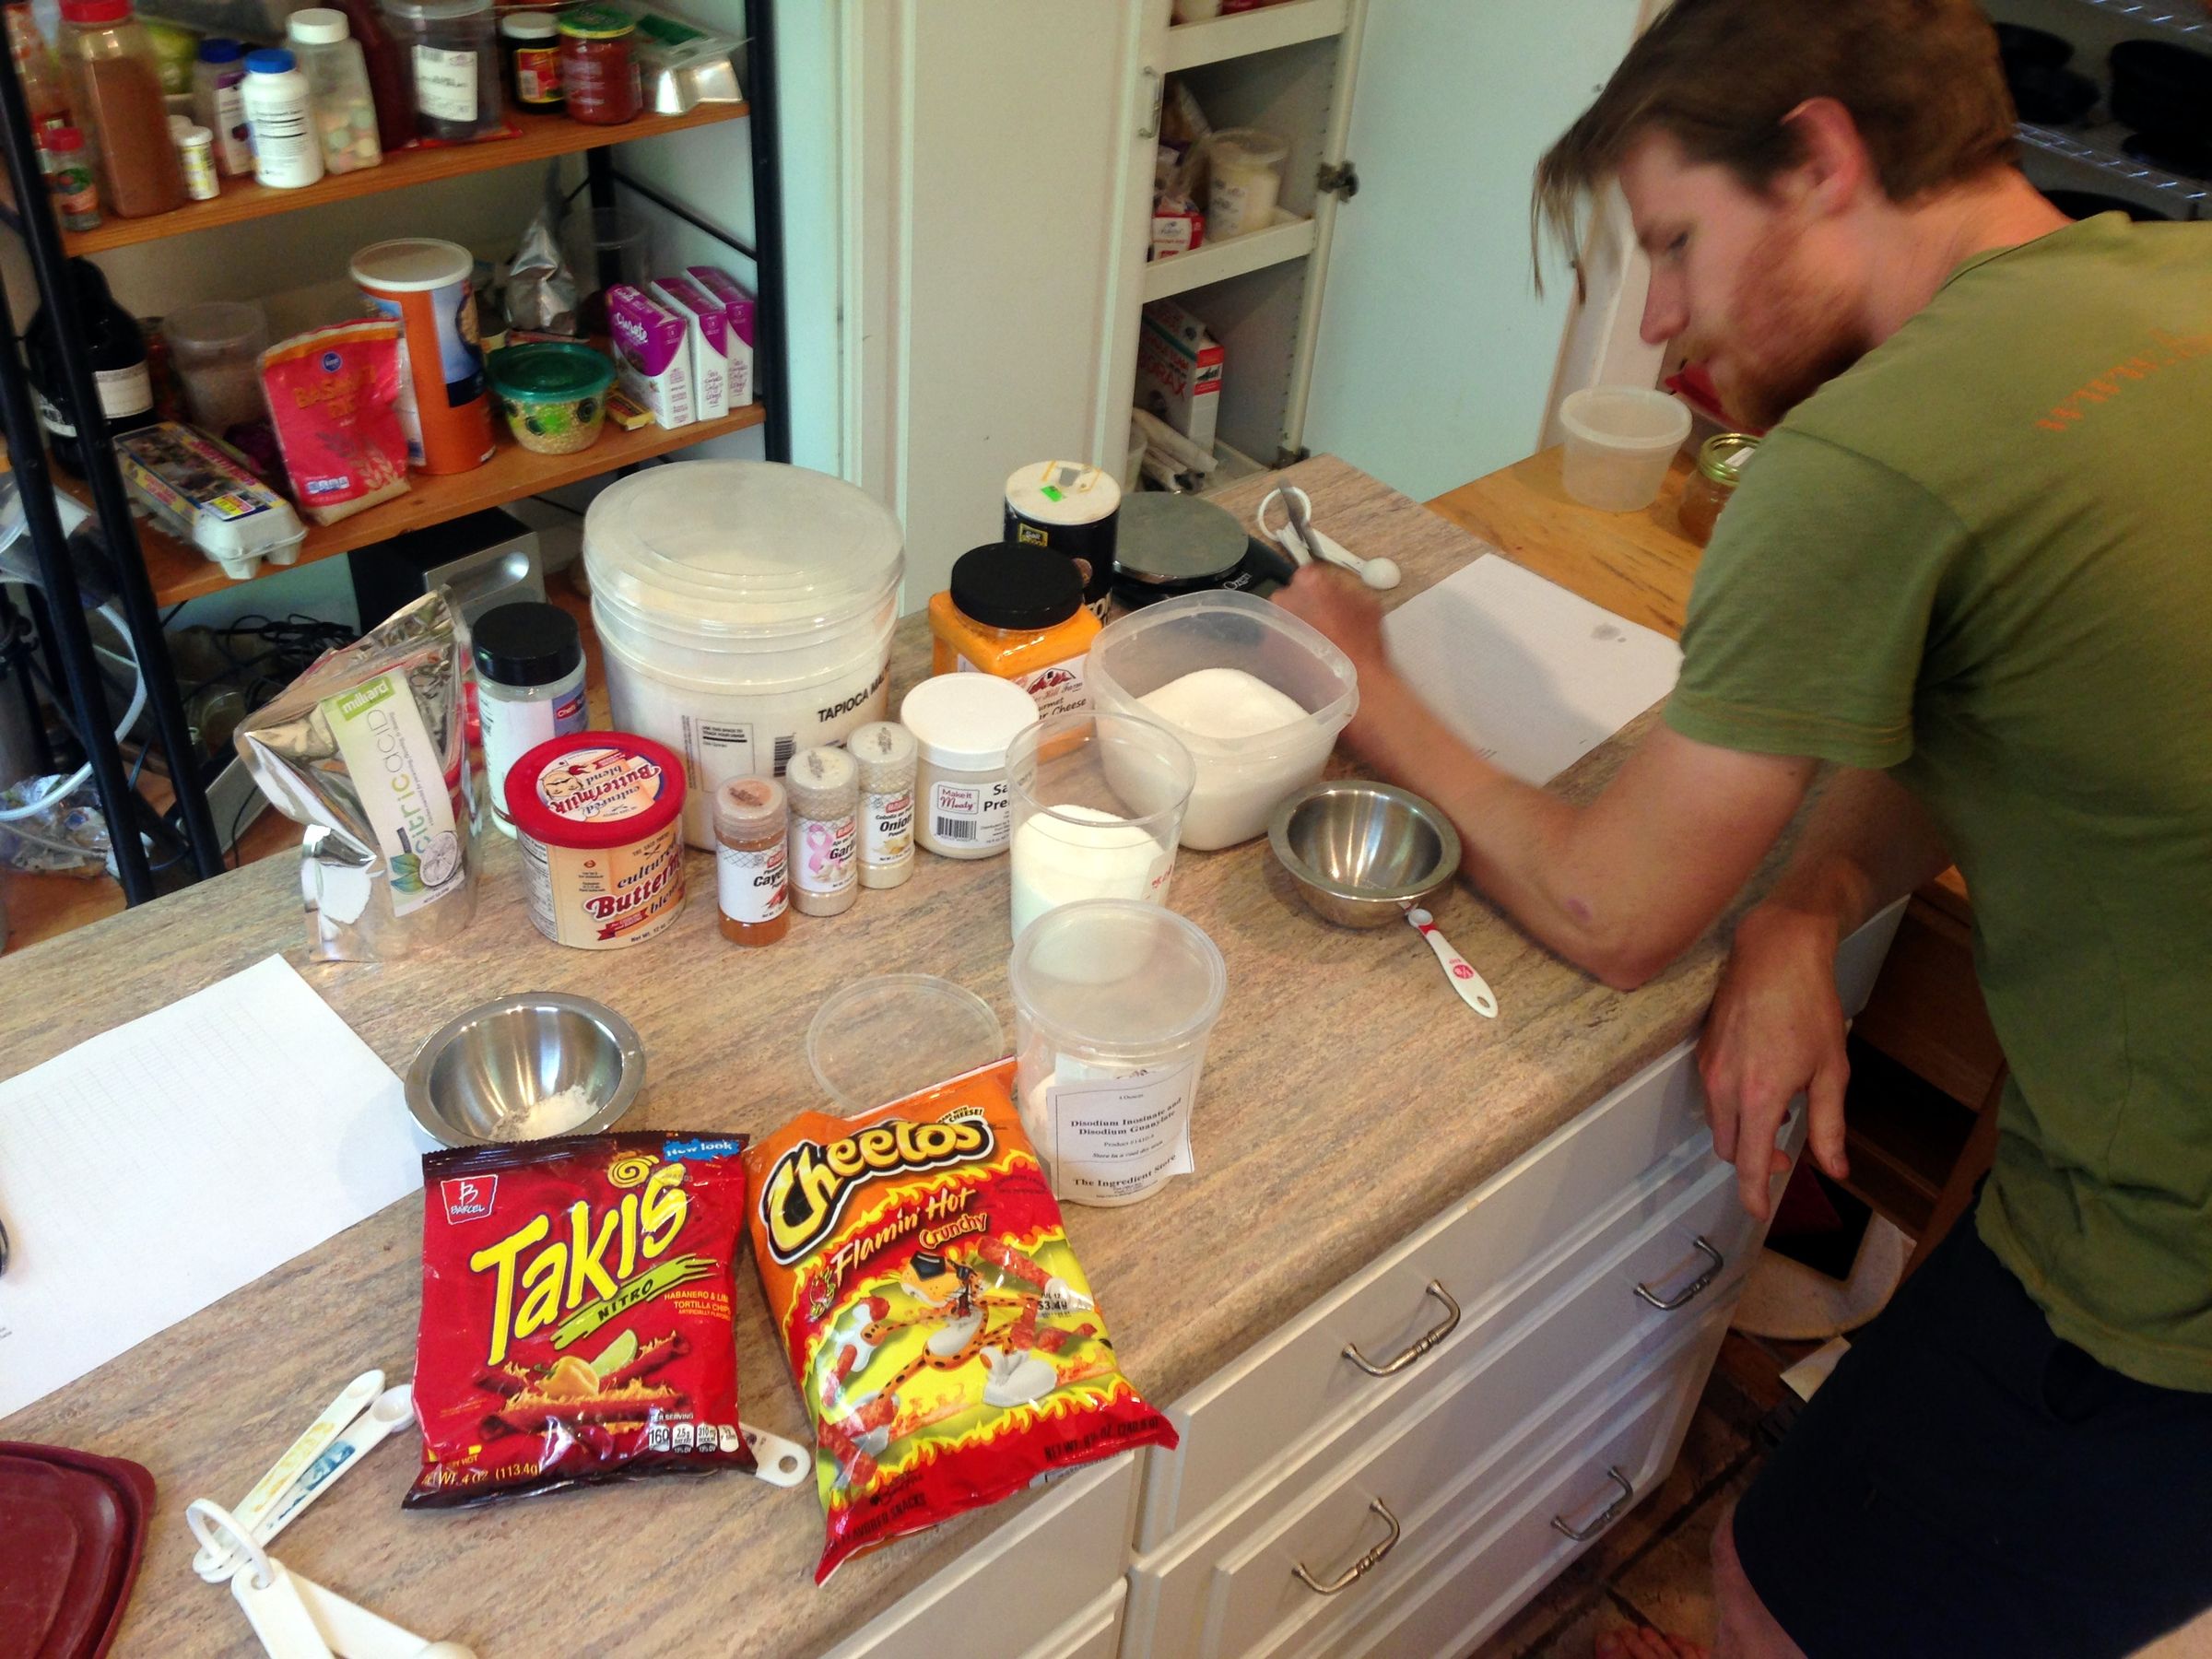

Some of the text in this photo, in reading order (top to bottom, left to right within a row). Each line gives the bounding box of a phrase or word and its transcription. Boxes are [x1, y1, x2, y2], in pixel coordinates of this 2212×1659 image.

[818, 688, 869, 724] TAPIOCA
[1052, 699, 1087, 716] Cheese
[549, 764, 661, 814] Buttermilk
[942, 788, 966, 799] Make
[879, 814, 912, 832] Onion
[949, 1108, 983, 1123] CHEESE!
[1123, 1110, 1166, 1127] Inosinate
[1167, 1097, 1182, 1112] and
[1130, 1110, 1175, 1134] Guanylate
[700, 1141, 733, 1151] look
[1074, 1154, 1176, 1188] The Ingredient Store
[766, 1121, 984, 1253] Cheetos
[450, 1204, 486, 1215] BARCEL
[924, 1186, 976, 1221] Hot
[919, 1212, 988, 1250] Crunchy
[469, 1162, 688, 1366] Takis
[597, 1279, 653, 1322] NITRO
[664, 1291, 710, 1300] HABANERO
[711, 1292, 716, 1300] &
[674, 1300, 712, 1310] TORTILLA
[649, 1429, 669, 1445] 160
